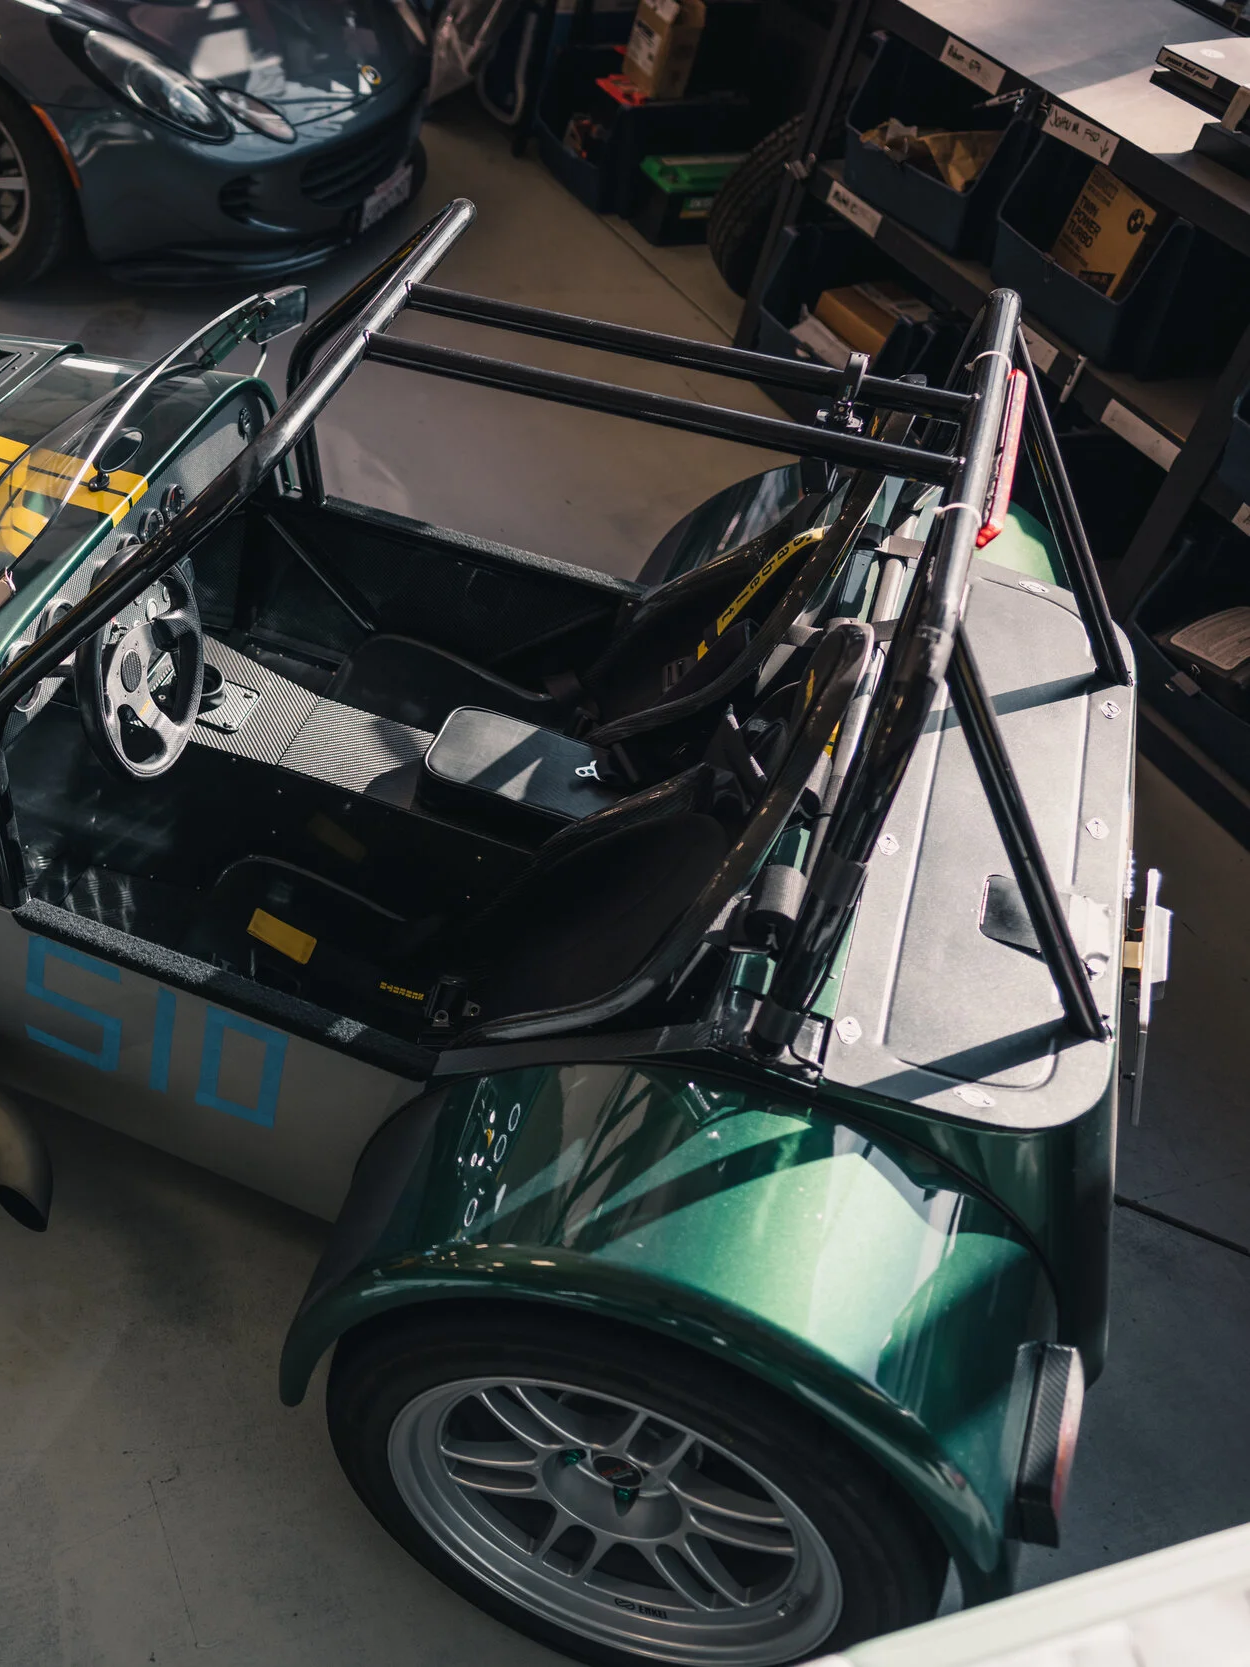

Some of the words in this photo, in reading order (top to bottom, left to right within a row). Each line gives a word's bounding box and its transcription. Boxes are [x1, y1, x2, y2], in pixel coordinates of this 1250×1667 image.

[1069, 218, 1094, 248] TURBO
[1073, 206, 1102, 238] POWER
[25, 934, 290, 1129] 510
